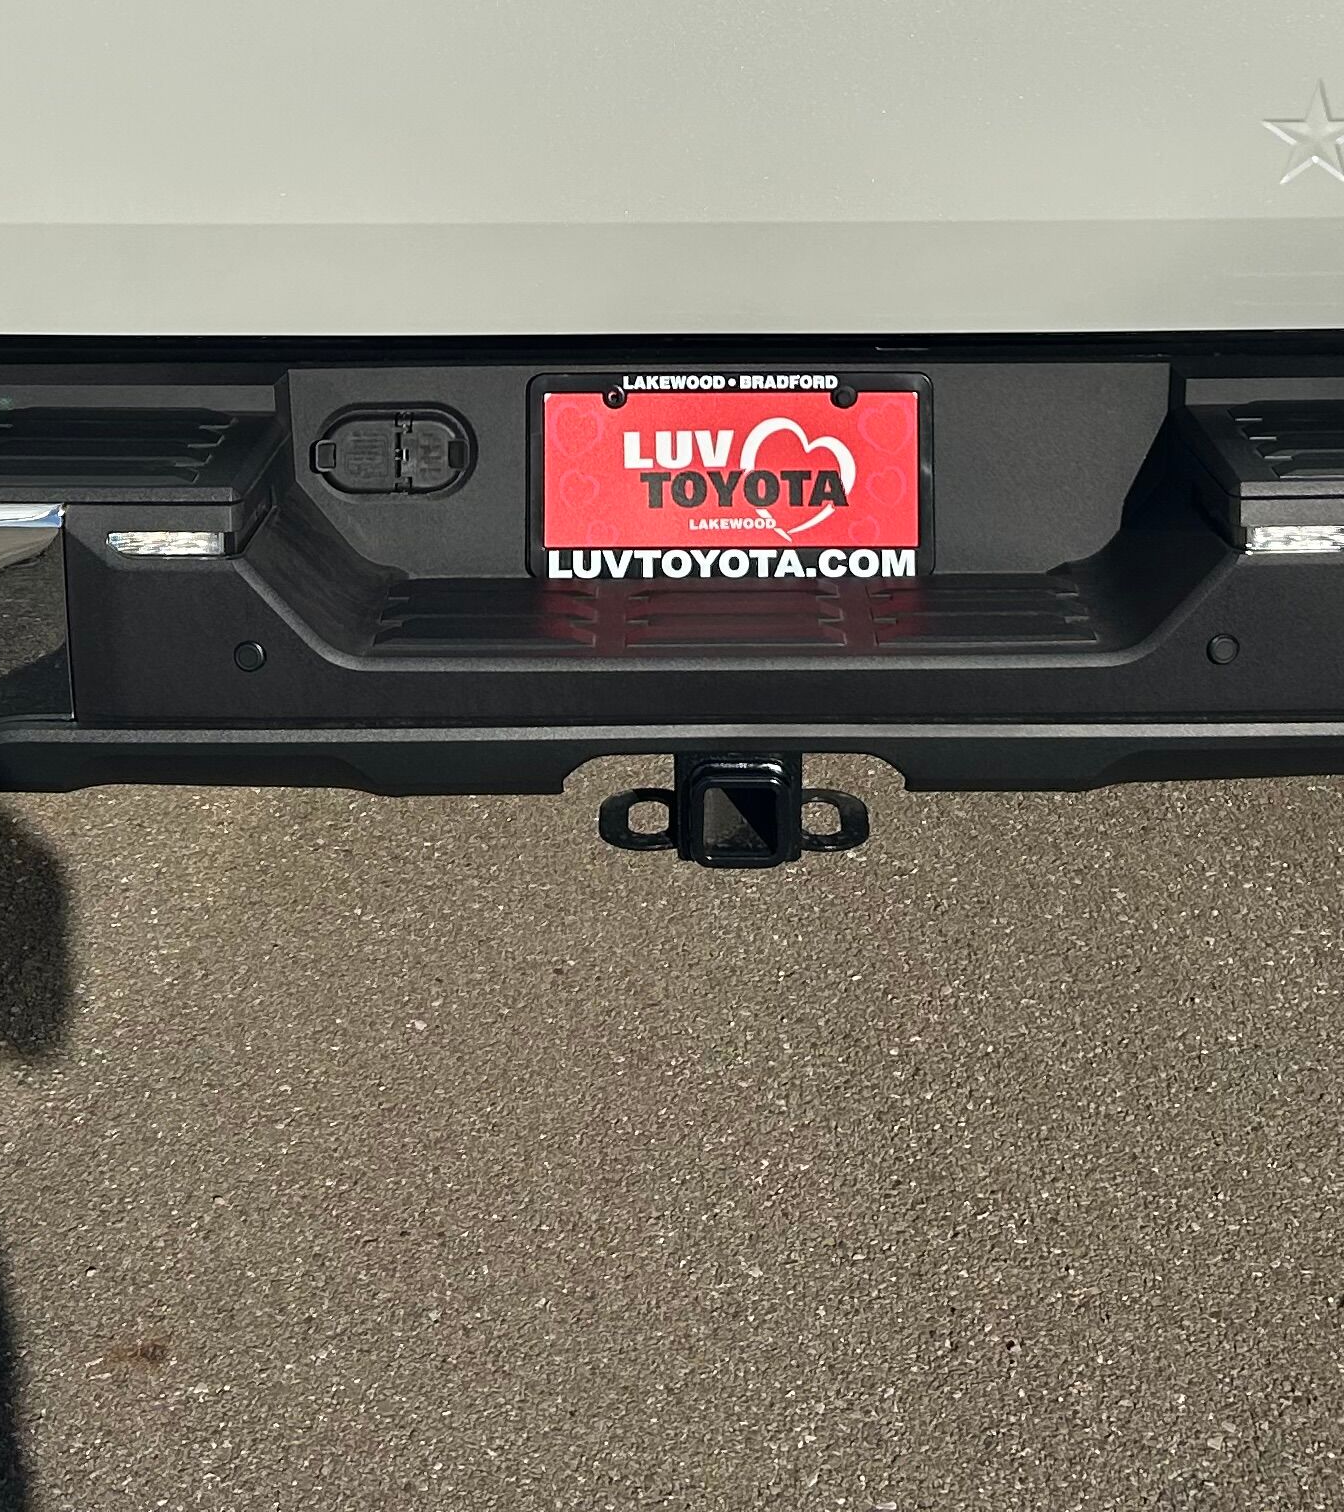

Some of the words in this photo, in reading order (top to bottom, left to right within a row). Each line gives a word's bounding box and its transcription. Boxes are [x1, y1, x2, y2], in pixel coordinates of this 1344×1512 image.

[622, 375, 725, 390] LAKEWOOD
[739, 375, 839, 390] BRADFORD
[622, 430, 735, 470] LUV
[640, 469, 850, 509] TOYOTA
[689, 517, 777, 531] LAKEWOOD
[548, 549, 916, 578] LUVTOYOTA.COM
